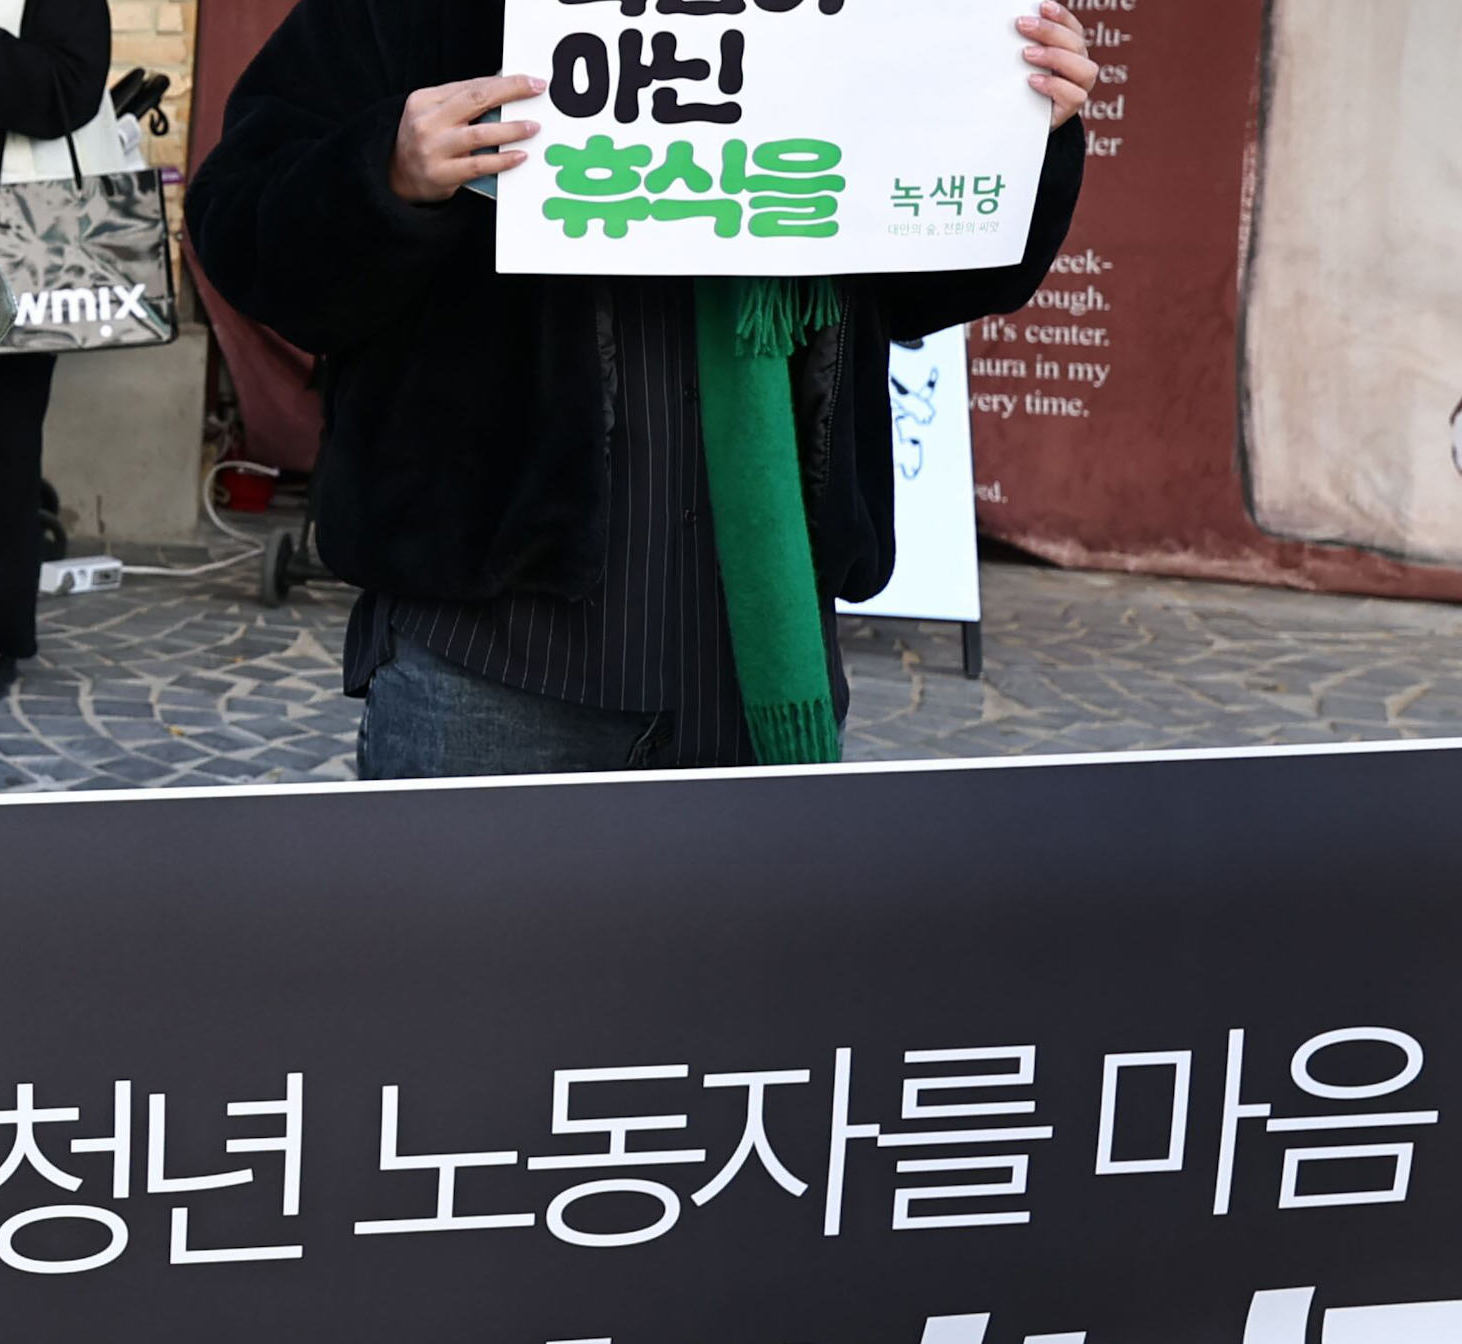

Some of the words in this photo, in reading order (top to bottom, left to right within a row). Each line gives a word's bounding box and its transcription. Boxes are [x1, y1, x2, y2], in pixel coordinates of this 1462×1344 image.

[549, 28, 744, 124] 아닌
[542, 134, 846, 238] 휴식을
[890, 174, 1006, 217] 녹색당
[982, 318, 1017, 343] it's
[1025, 322, 1110, 347] center.
[971, 356, 1026, 379] aura
[1035, 354, 1059, 379] in
[1067, 361, 1110, 388] my
[968, 393, 1017, 419] very
[1025, 390, 1089, 417] time.
[354, 1042, 1055, 1247] 노동자를
[1095, 1026, 1440, 1216] 마음
